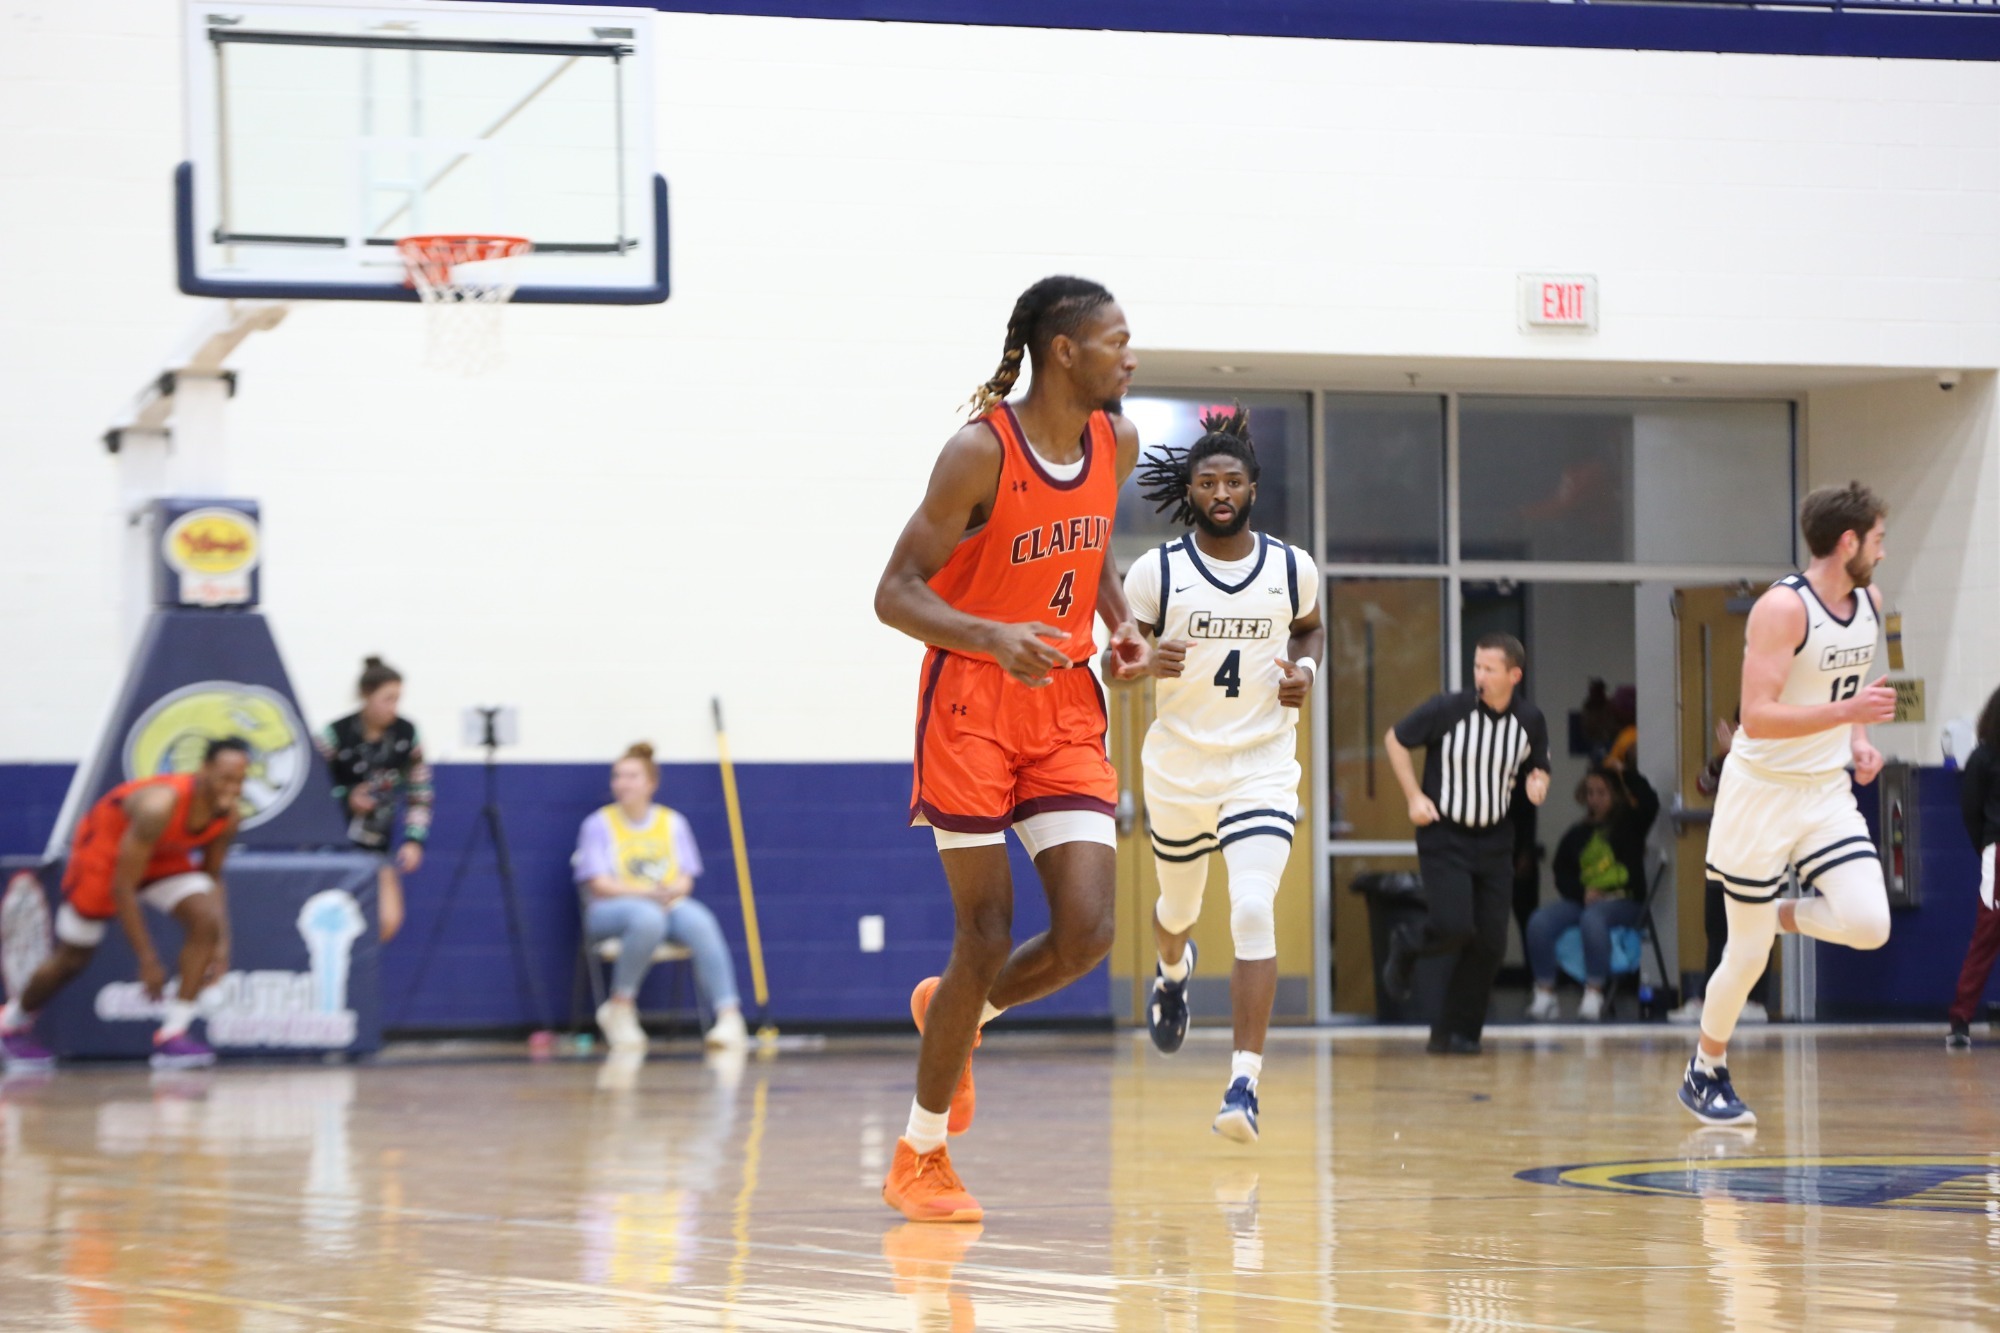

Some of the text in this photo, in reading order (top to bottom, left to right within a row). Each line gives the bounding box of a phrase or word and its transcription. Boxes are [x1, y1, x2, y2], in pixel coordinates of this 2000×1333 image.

[1542, 283, 1585, 319] EXIT
[1047, 569, 1076, 618] 4
[1268, 587, 1284, 595] SAC
[1188, 610, 1272, 639] COKER
[1213, 649, 1241, 698] 4
[1830, 674, 1860, 703] 12
